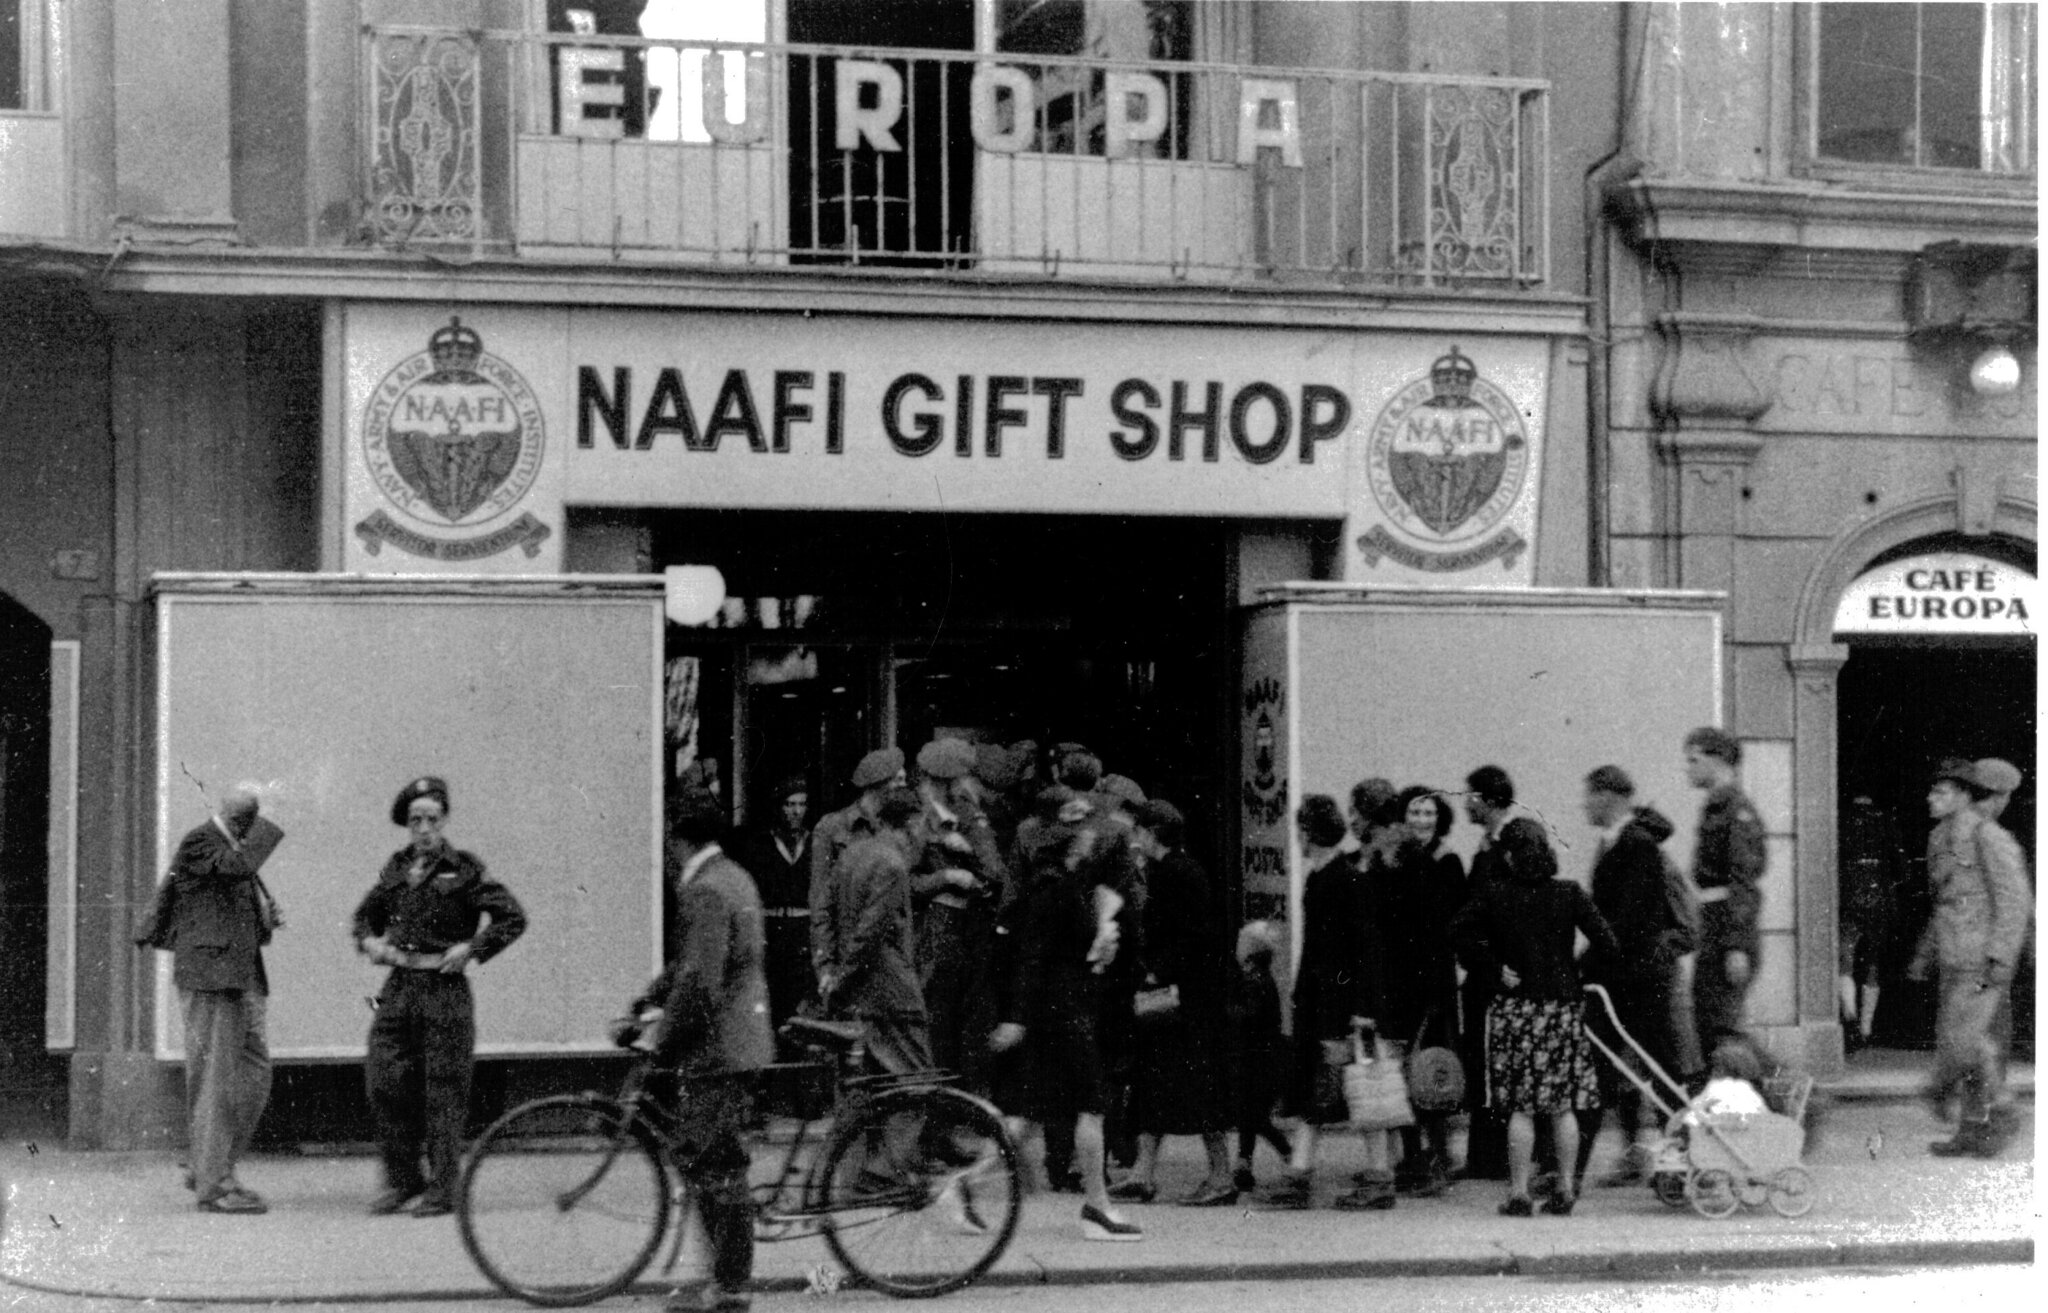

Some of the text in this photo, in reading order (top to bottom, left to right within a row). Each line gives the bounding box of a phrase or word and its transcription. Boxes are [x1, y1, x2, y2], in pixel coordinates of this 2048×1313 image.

[559, 47, 1303, 167] EUROPA
[577, 365, 1351, 464] NAAFI GIFT SHOP
[1868, 596, 2029, 619] EUROPA
[1905, 564, 1996, 592] CAFÉ
